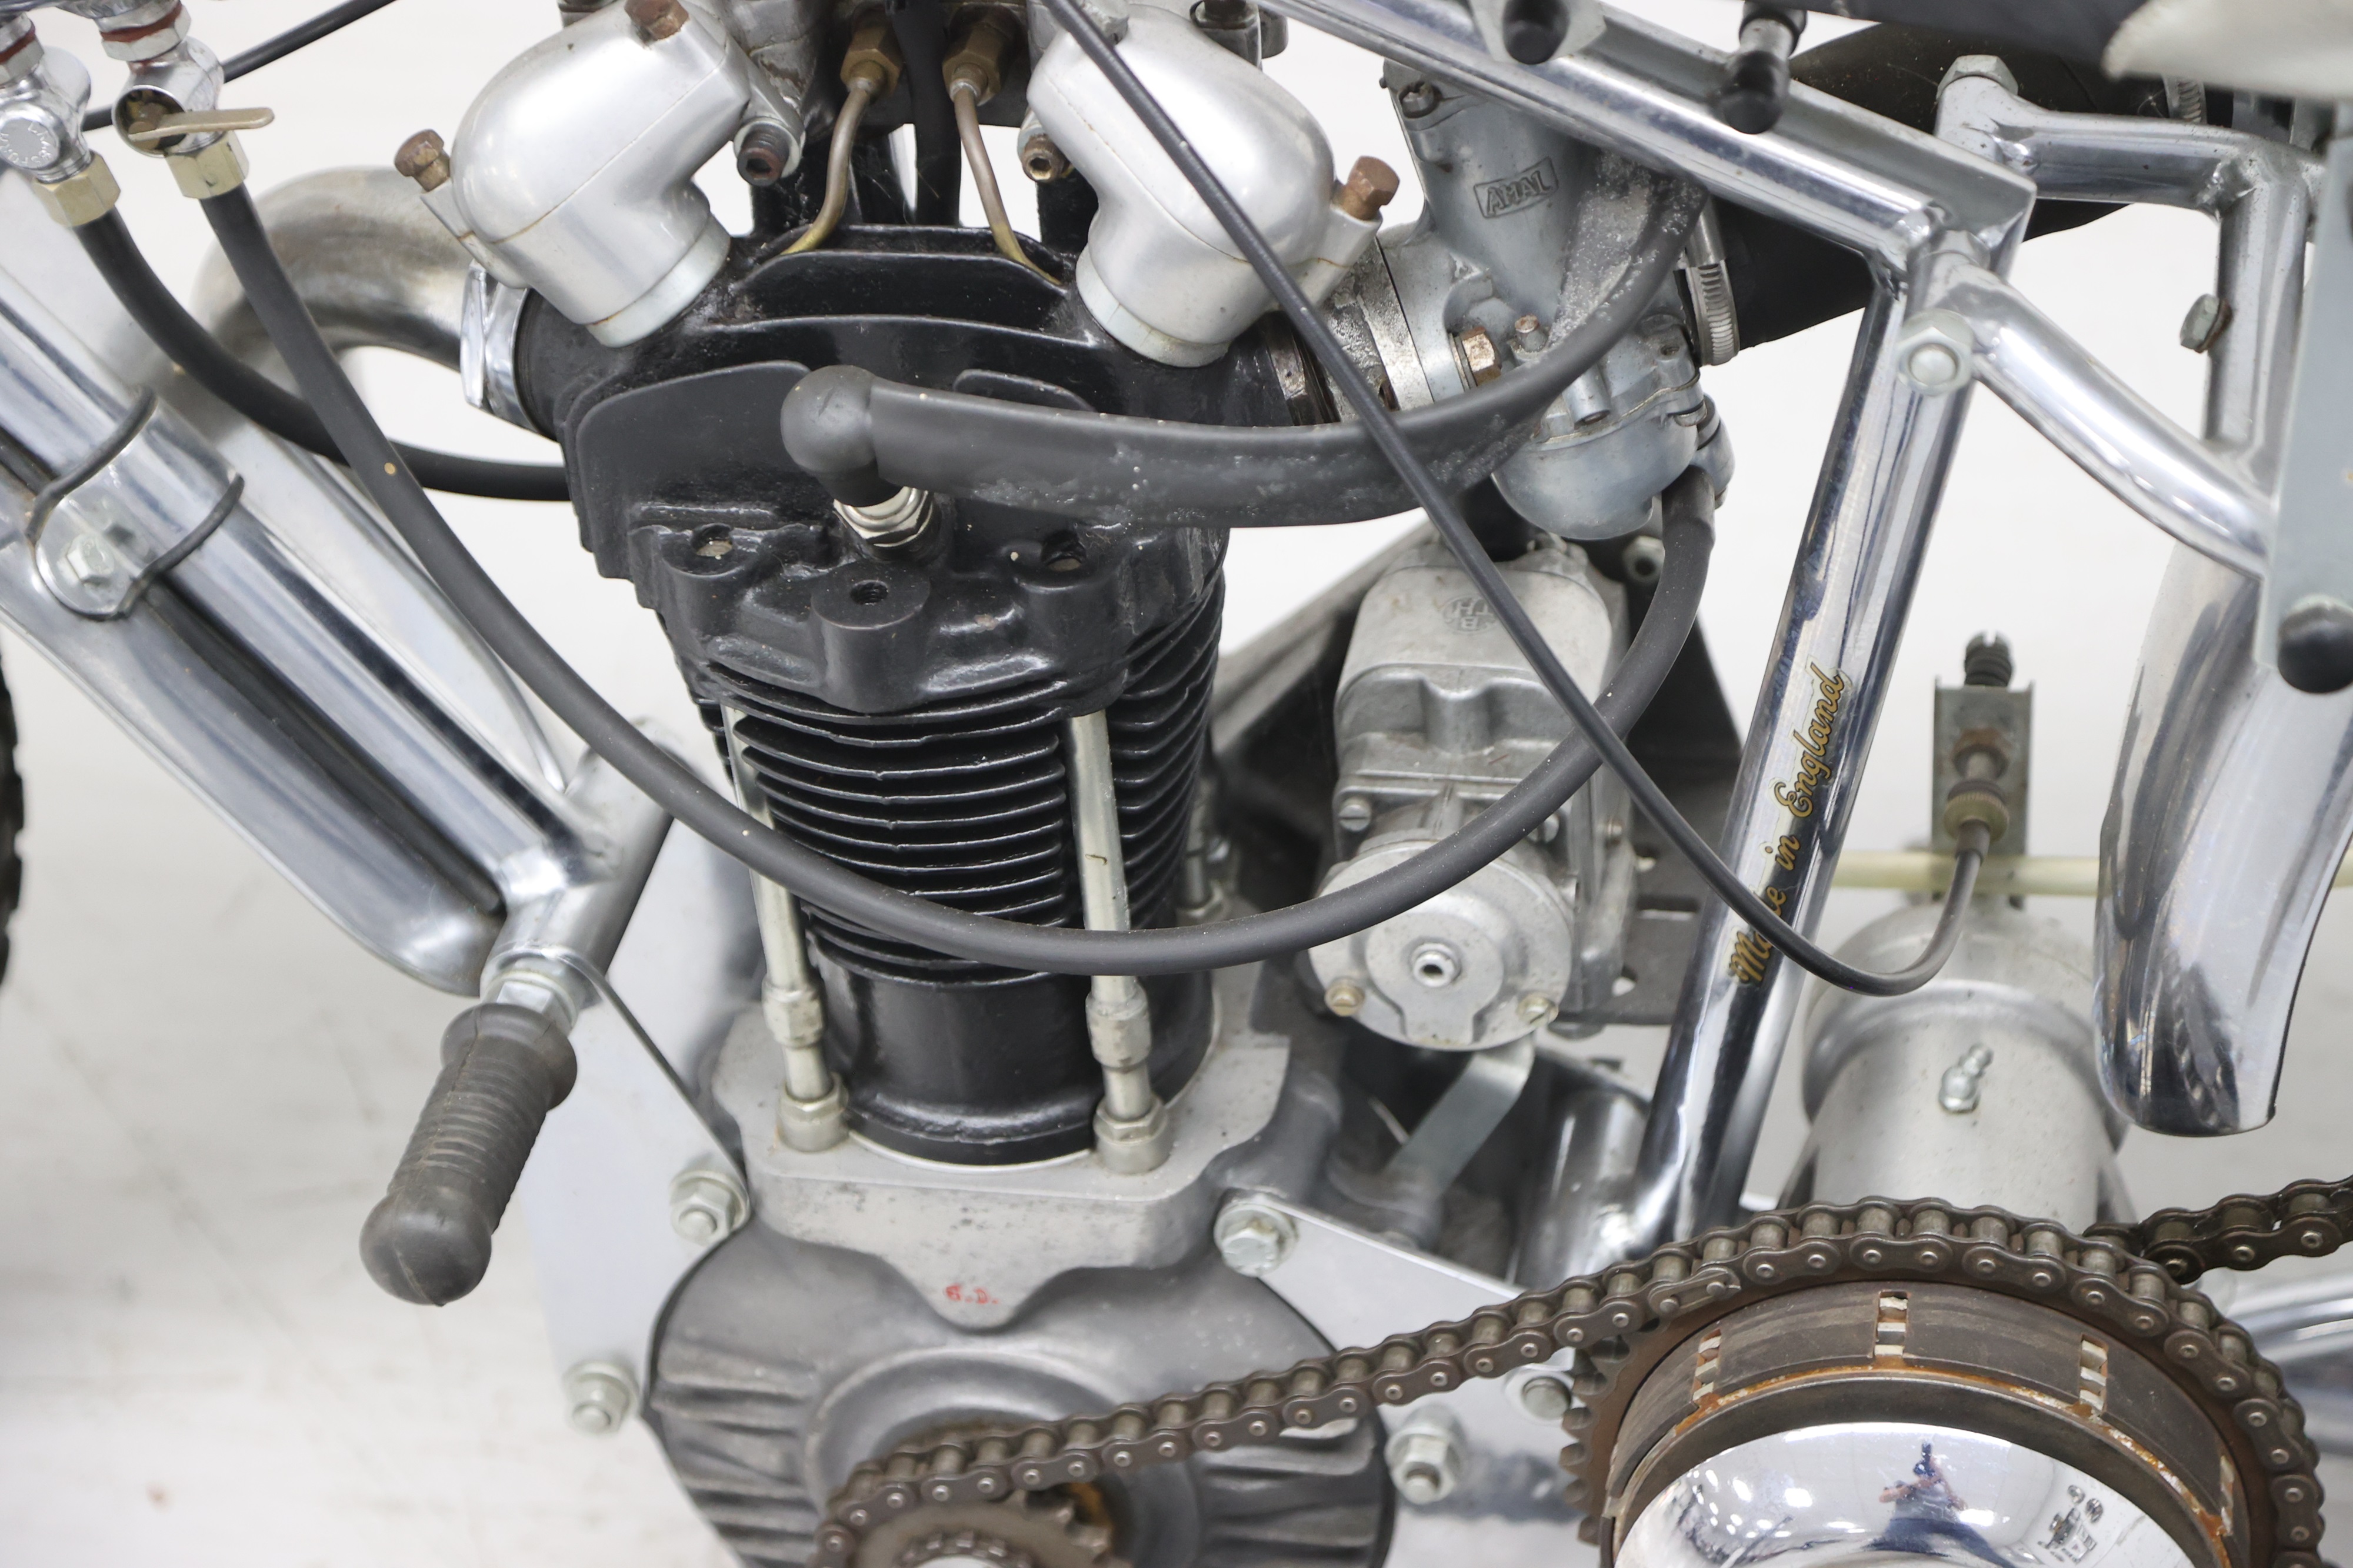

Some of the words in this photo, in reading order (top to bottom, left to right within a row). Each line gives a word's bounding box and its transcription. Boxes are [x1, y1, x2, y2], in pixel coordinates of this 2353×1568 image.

[1486, 170, 1551, 216] AMAL
[1774, 661, 1845, 818] England
[1764, 834, 1801, 871] in
